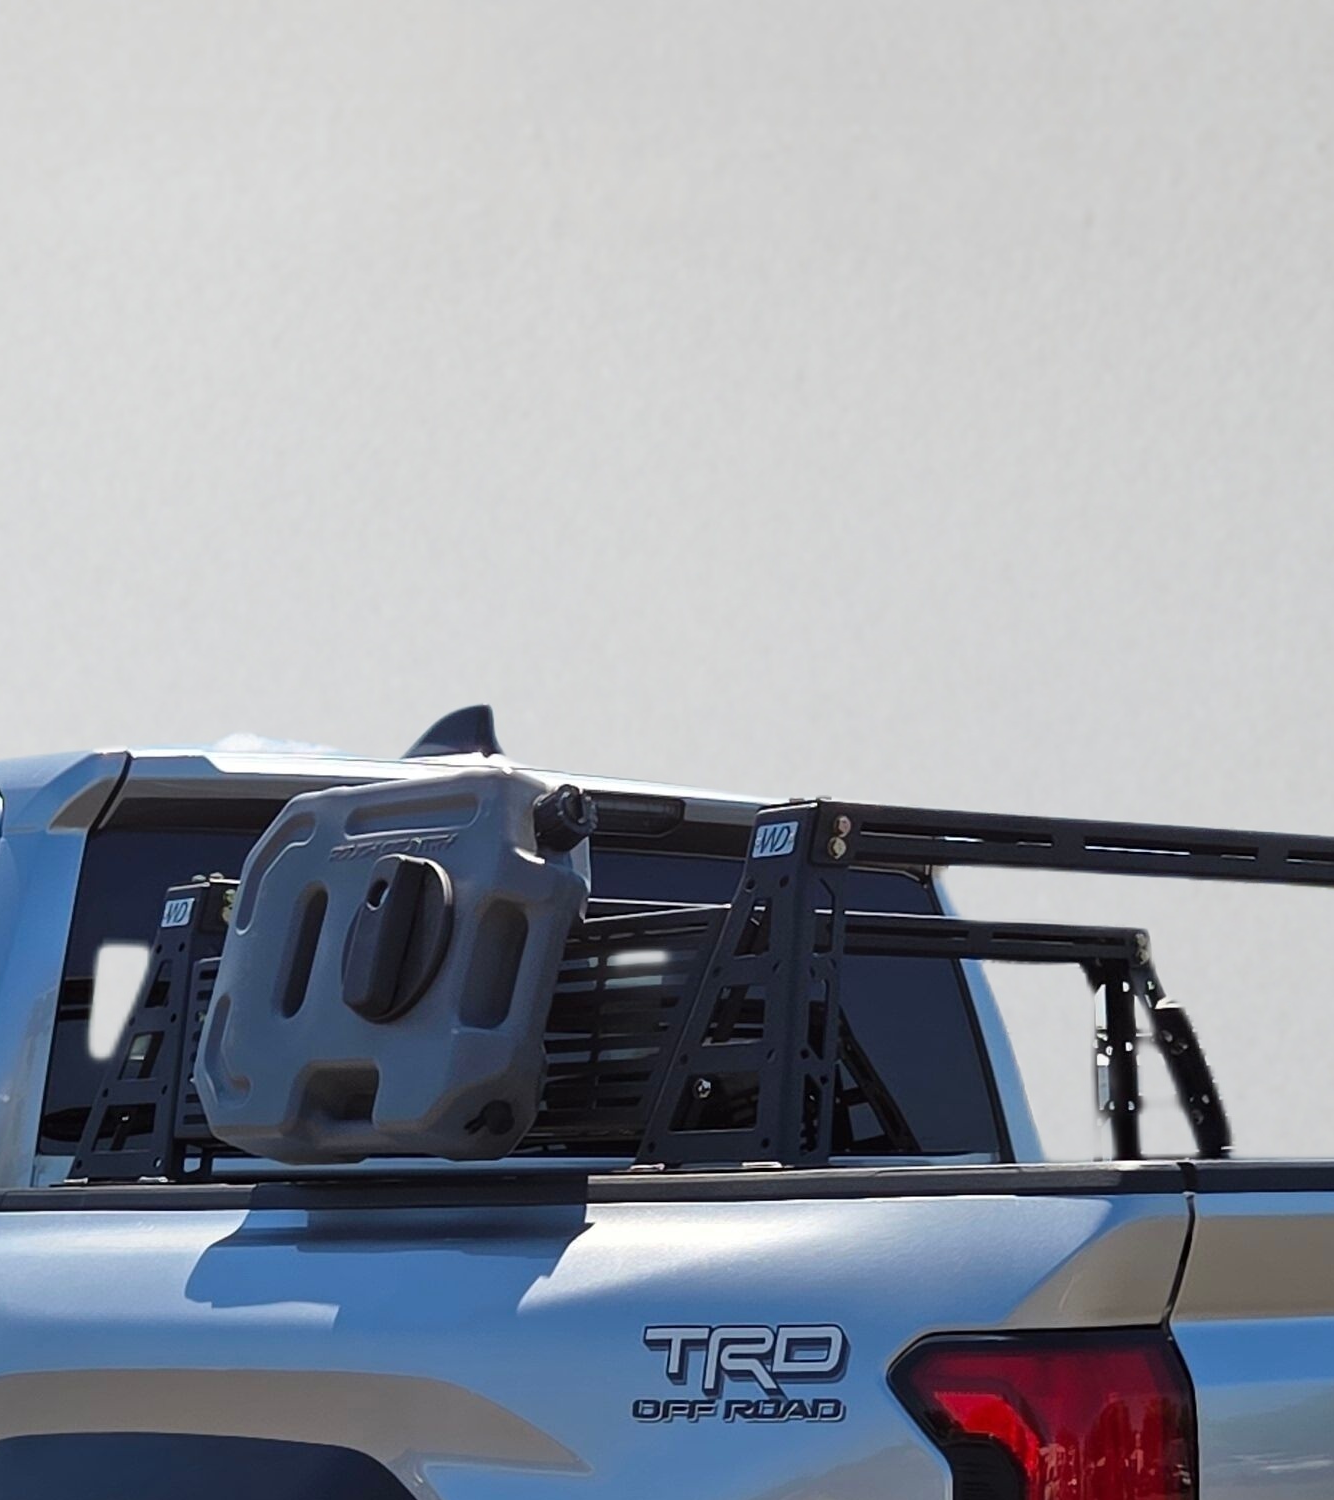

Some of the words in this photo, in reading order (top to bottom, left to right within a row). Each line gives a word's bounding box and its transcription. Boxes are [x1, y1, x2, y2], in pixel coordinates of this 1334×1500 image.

[643, 1323, 851, 1400] TRD
[632, 1398, 717, 1423] OFF
[723, 1398, 847, 1423] ROAD
